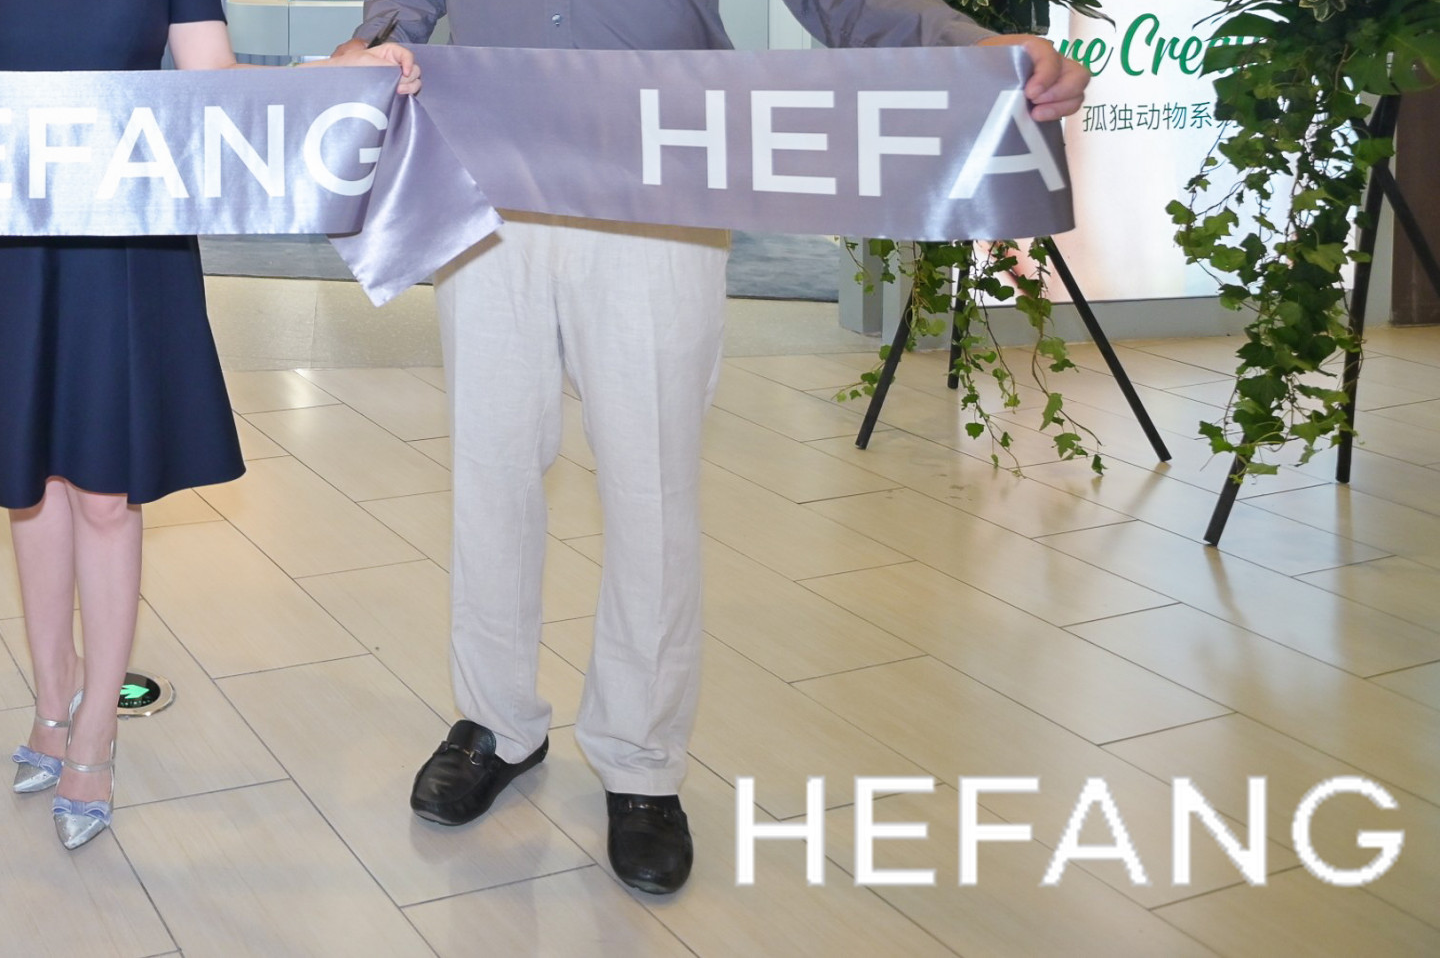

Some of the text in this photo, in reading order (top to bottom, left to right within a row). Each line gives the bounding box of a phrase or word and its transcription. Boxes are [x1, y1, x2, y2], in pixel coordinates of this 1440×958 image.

[639, 87, 1067, 200] HEFA
[1082, 101, 1240, 133] 孤独动物系
